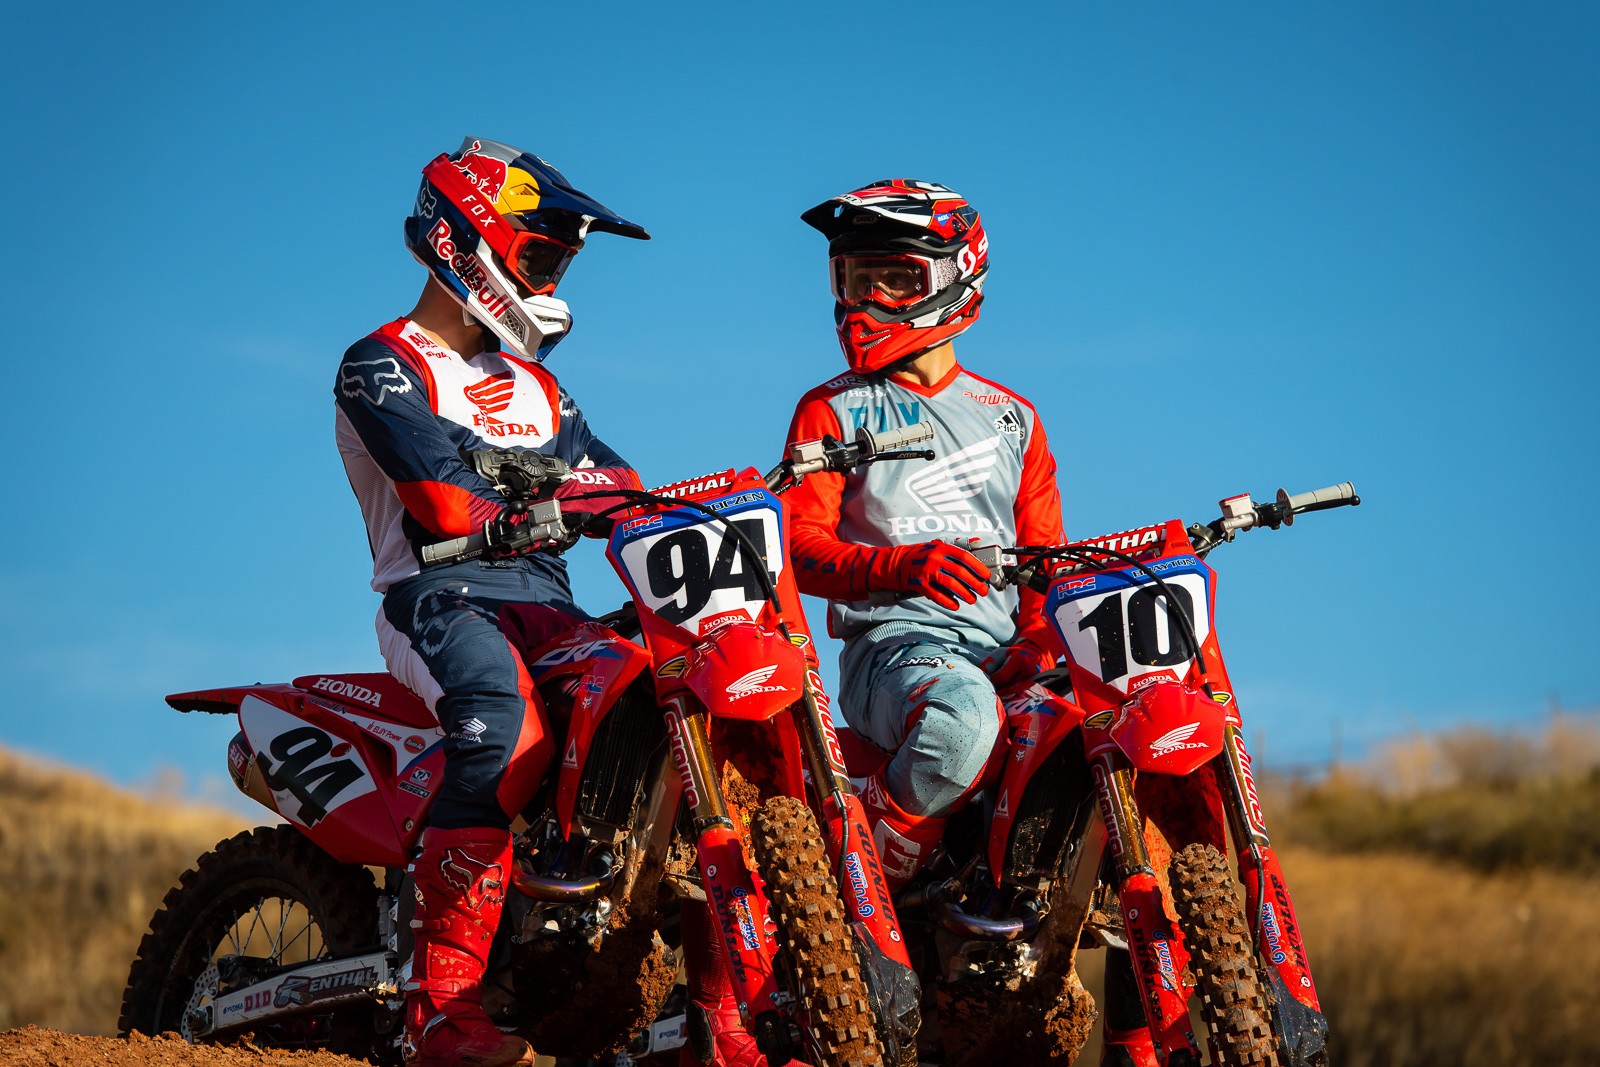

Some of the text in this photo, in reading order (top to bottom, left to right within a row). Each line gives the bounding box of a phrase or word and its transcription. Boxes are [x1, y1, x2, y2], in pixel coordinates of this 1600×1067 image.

[462, 194, 496, 228] FOX
[622, 513, 664, 538] HRC
[646, 518, 777, 627] 94
[1057, 577, 1096, 600] HRC
[703, 614, 747, 631] HONDA
[1078, 583, 1197, 683] 10
[313, 677, 383, 708] HONDA
[728, 684, 789, 703] HONDA
[1132, 674, 1175, 690] HONDA
[1152, 741, 1210, 760] HONDA
[255, 726, 366, 829] 94
[845, 852, 869, 908] YUTAKA
[856, 822, 897, 925] DUNLOP
[1261, 902, 1281, 956] YUTAKA
[1270, 873, 1308, 977] DUNLOP
[244, 990, 272, 1012] D.I.D
